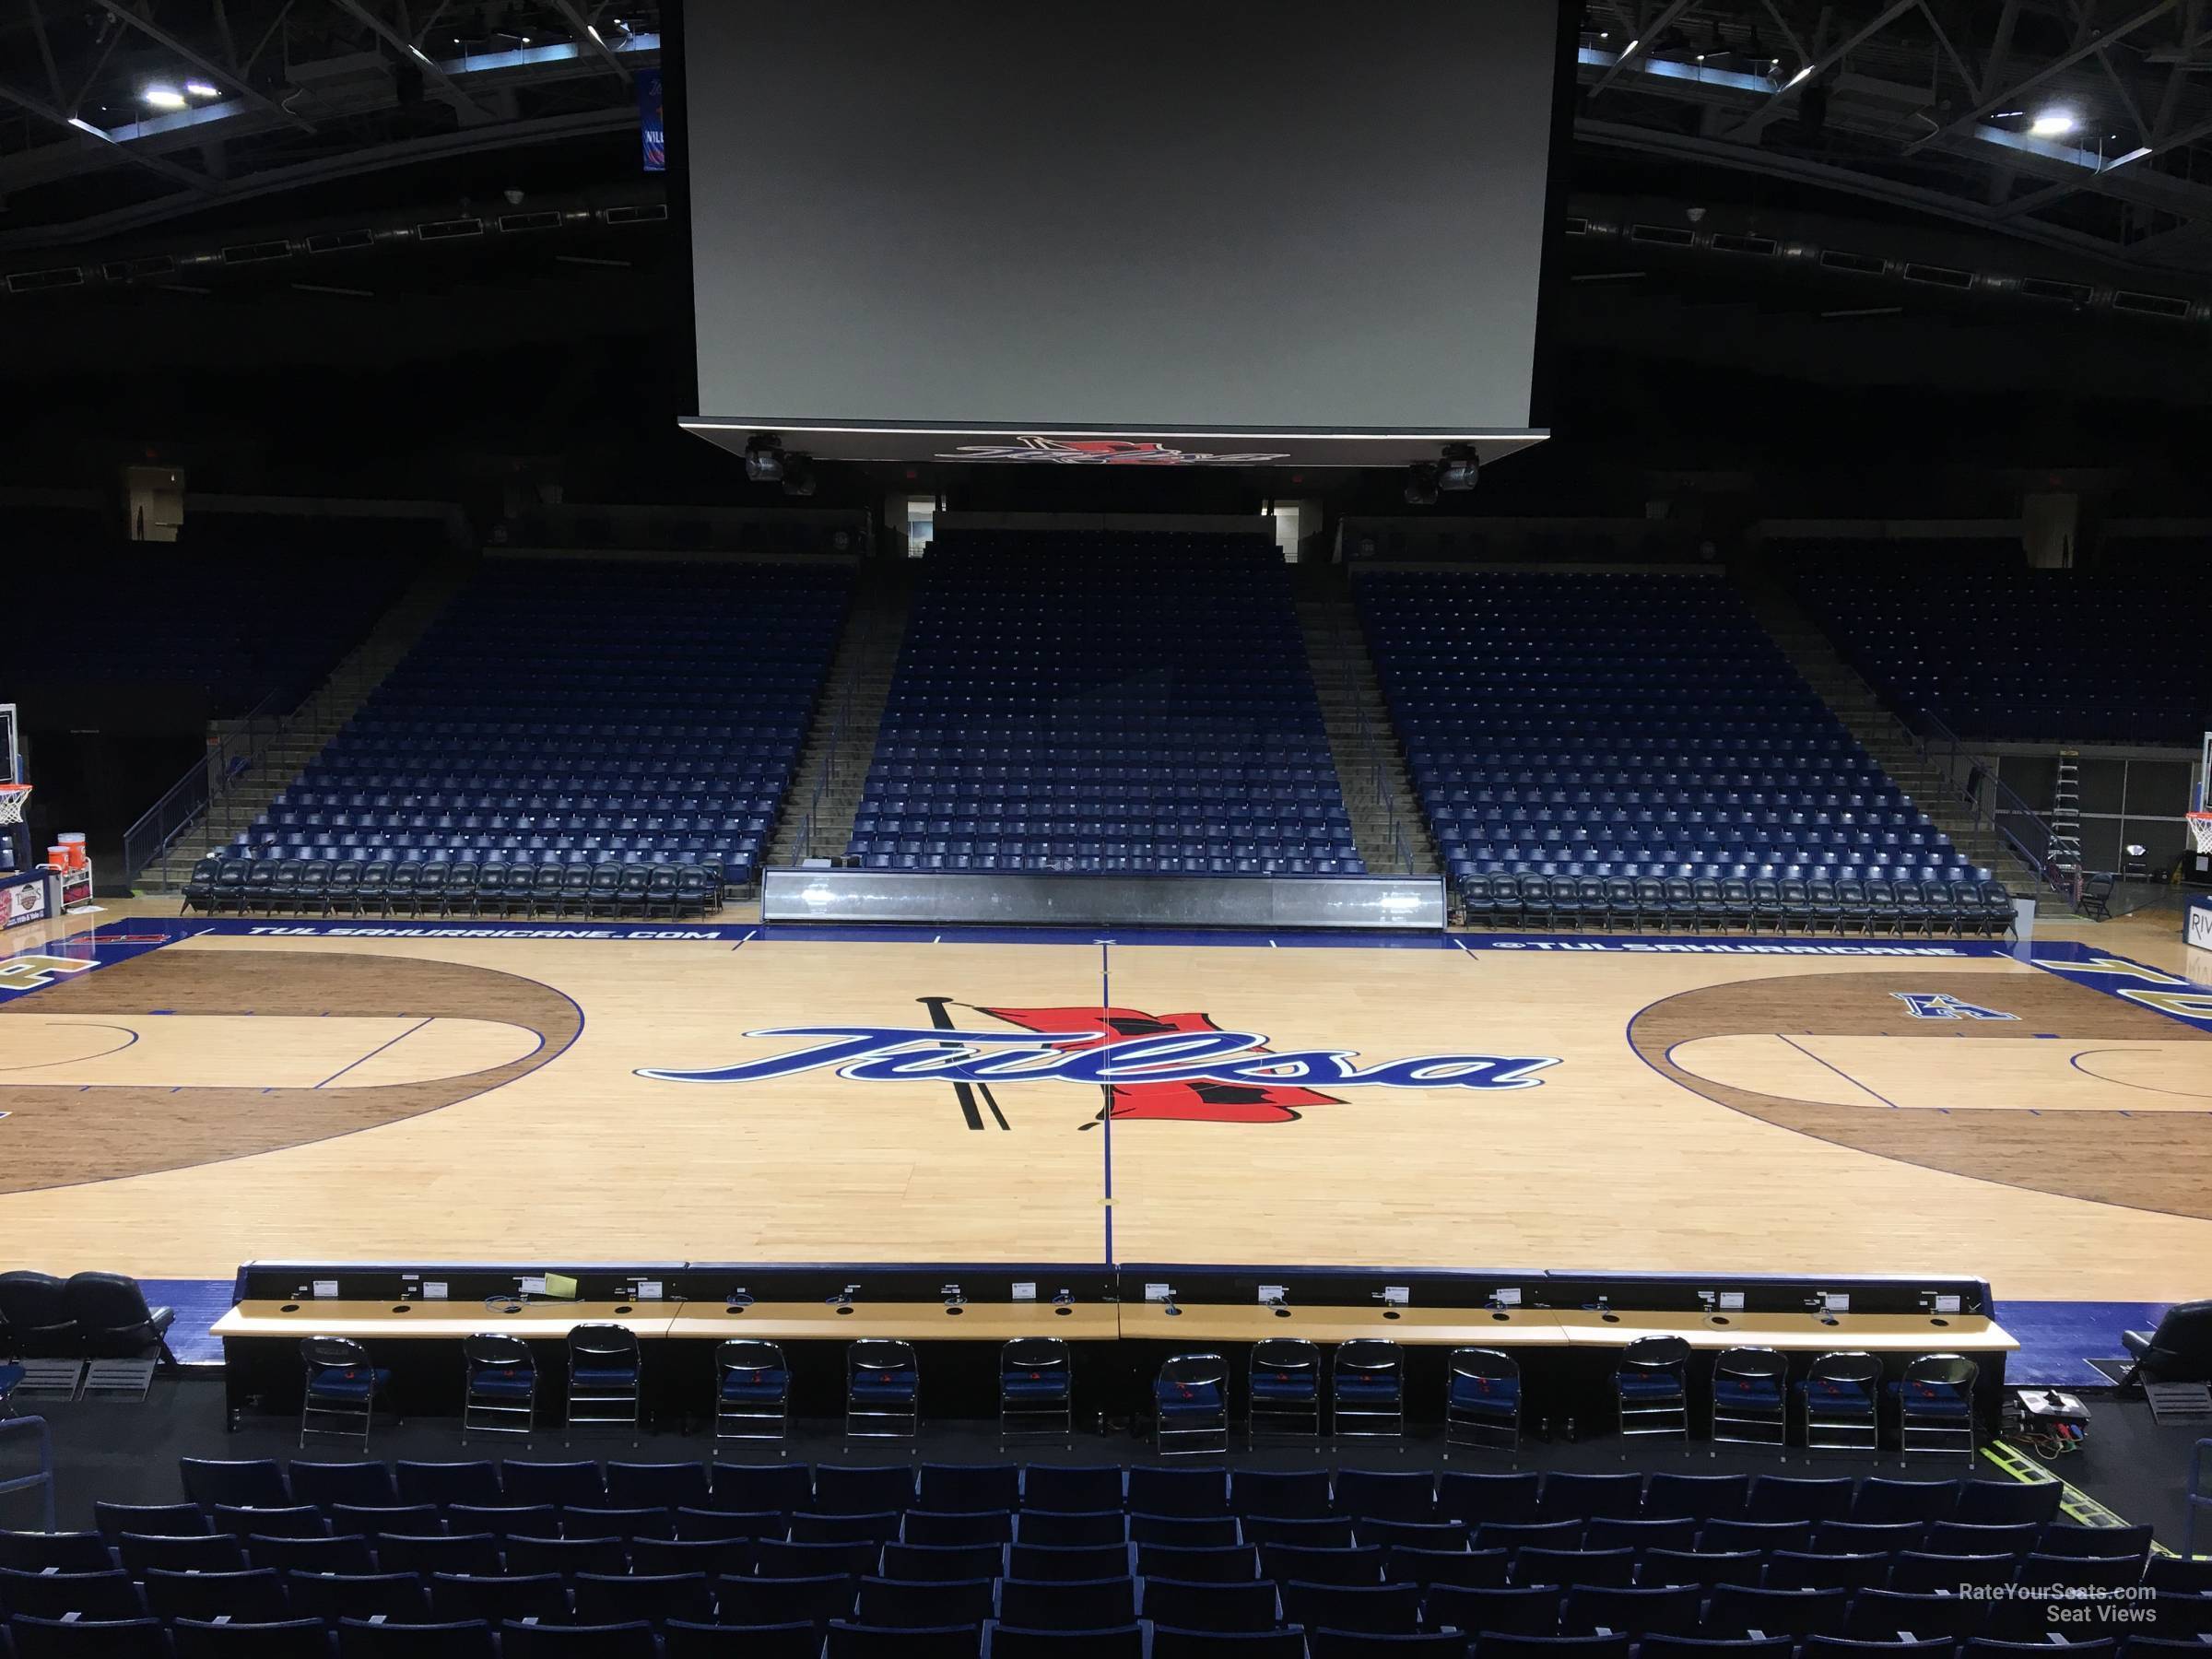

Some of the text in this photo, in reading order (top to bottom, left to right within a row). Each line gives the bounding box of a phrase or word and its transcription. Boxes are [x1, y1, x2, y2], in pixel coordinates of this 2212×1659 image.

[248, 926, 722, 939] TULSAHURRICANE.COM
[1491, 941, 1968, 957] @TULSAHURRICANE
[630, 1026, 1564, 1091] Tulsa
